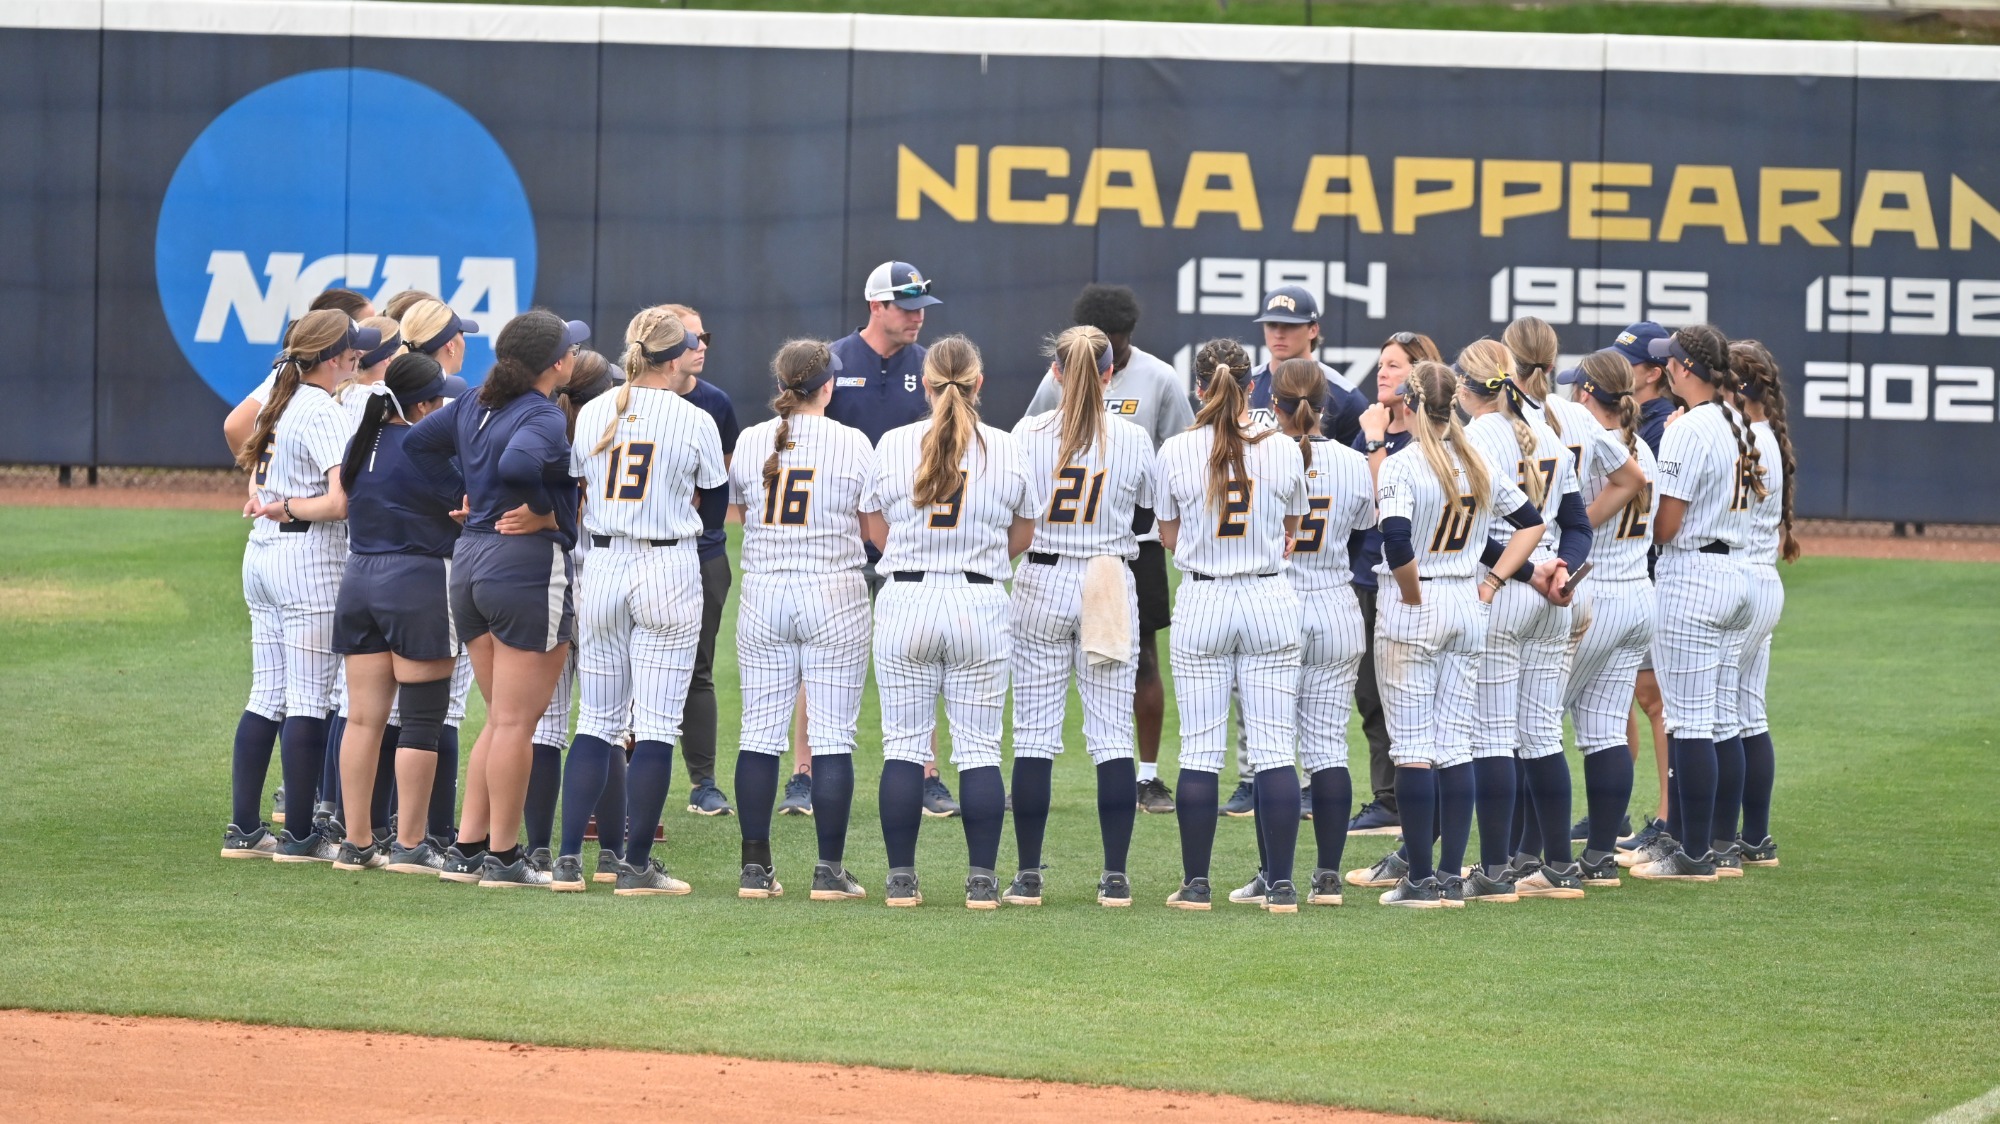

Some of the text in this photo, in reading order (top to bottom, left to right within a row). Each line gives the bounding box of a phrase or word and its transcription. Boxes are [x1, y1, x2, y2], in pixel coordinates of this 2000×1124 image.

[897, 143, 1264, 231] NCAA
[1177, 257, 1388, 319] 1994
[1490, 266, 1709, 328] 1995
[1104, 399, 1139, 414] CG
[1803, 361, 2000, 423] 202
[604, 440, 657, 501] 13
[763, 467, 817, 526] 16
[1047, 465, 1108, 524] 21
[1216, 478, 1255, 539] 2
[1293, 496, 1332, 552] 5
[1429, 494, 1480, 553] 10
